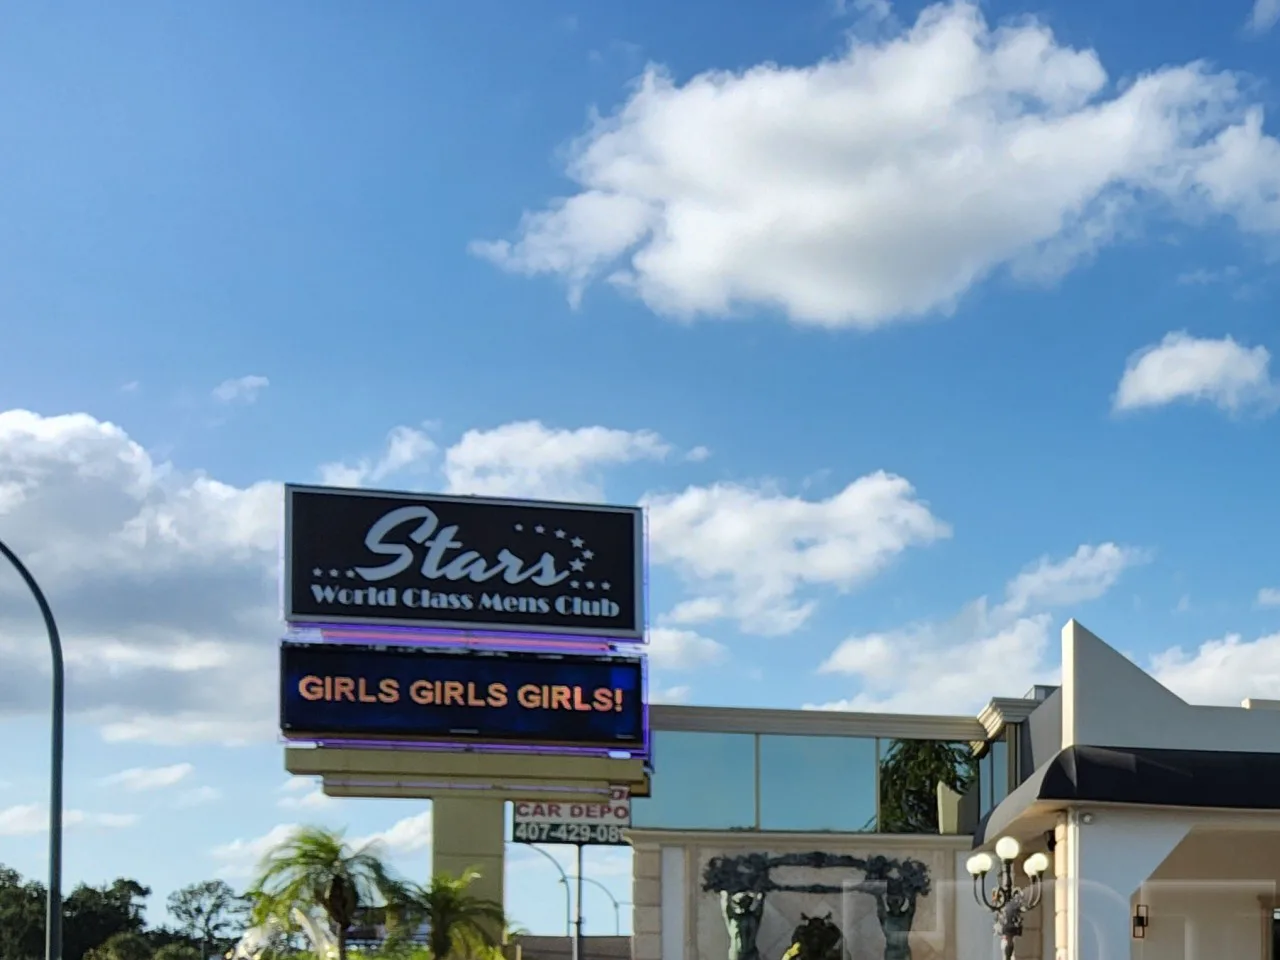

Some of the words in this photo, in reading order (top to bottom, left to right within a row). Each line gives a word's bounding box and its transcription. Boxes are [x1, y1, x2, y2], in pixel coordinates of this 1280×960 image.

[354, 504, 571, 587] Stars
[311, 583, 398, 608] World
[402, 587, 474, 611] Class
[478, 591, 550, 615] Mens
[555, 594, 620, 618] Club
[298, 675, 400, 704] GIRLS
[409, 680, 508, 708] GIRLS
[517, 684, 624, 713] GIRLS!
[516, 803, 562, 818] CAR
